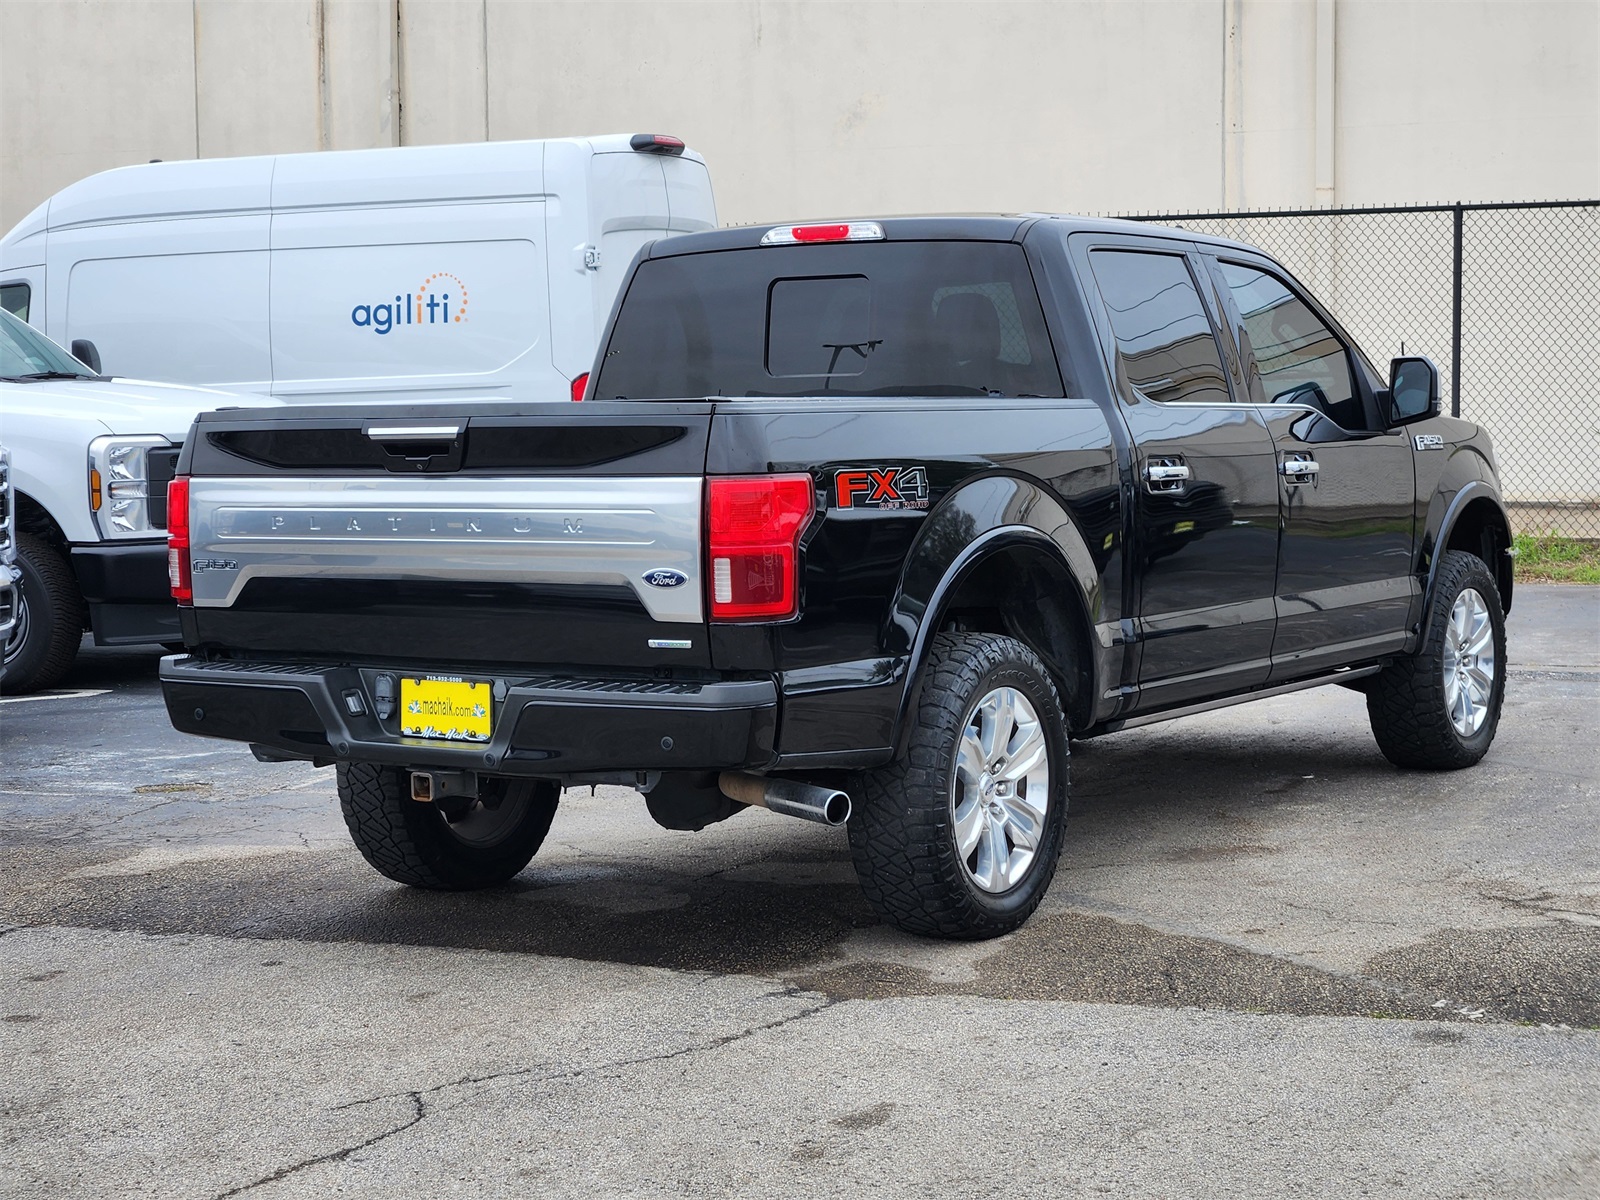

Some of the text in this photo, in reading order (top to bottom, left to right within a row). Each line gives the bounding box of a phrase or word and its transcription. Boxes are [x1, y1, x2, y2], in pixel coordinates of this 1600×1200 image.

[351, 293, 449, 335] agiliti
[834, 467, 929, 511] FX4
[879, 500, 930, 510] OFF ROAD
[271, 516, 583, 533] PLATINUM
[422, 697, 471, 717] machaik.com
[421, 726, 444, 739] Mac
[445, 728, 469, 740] Haik
